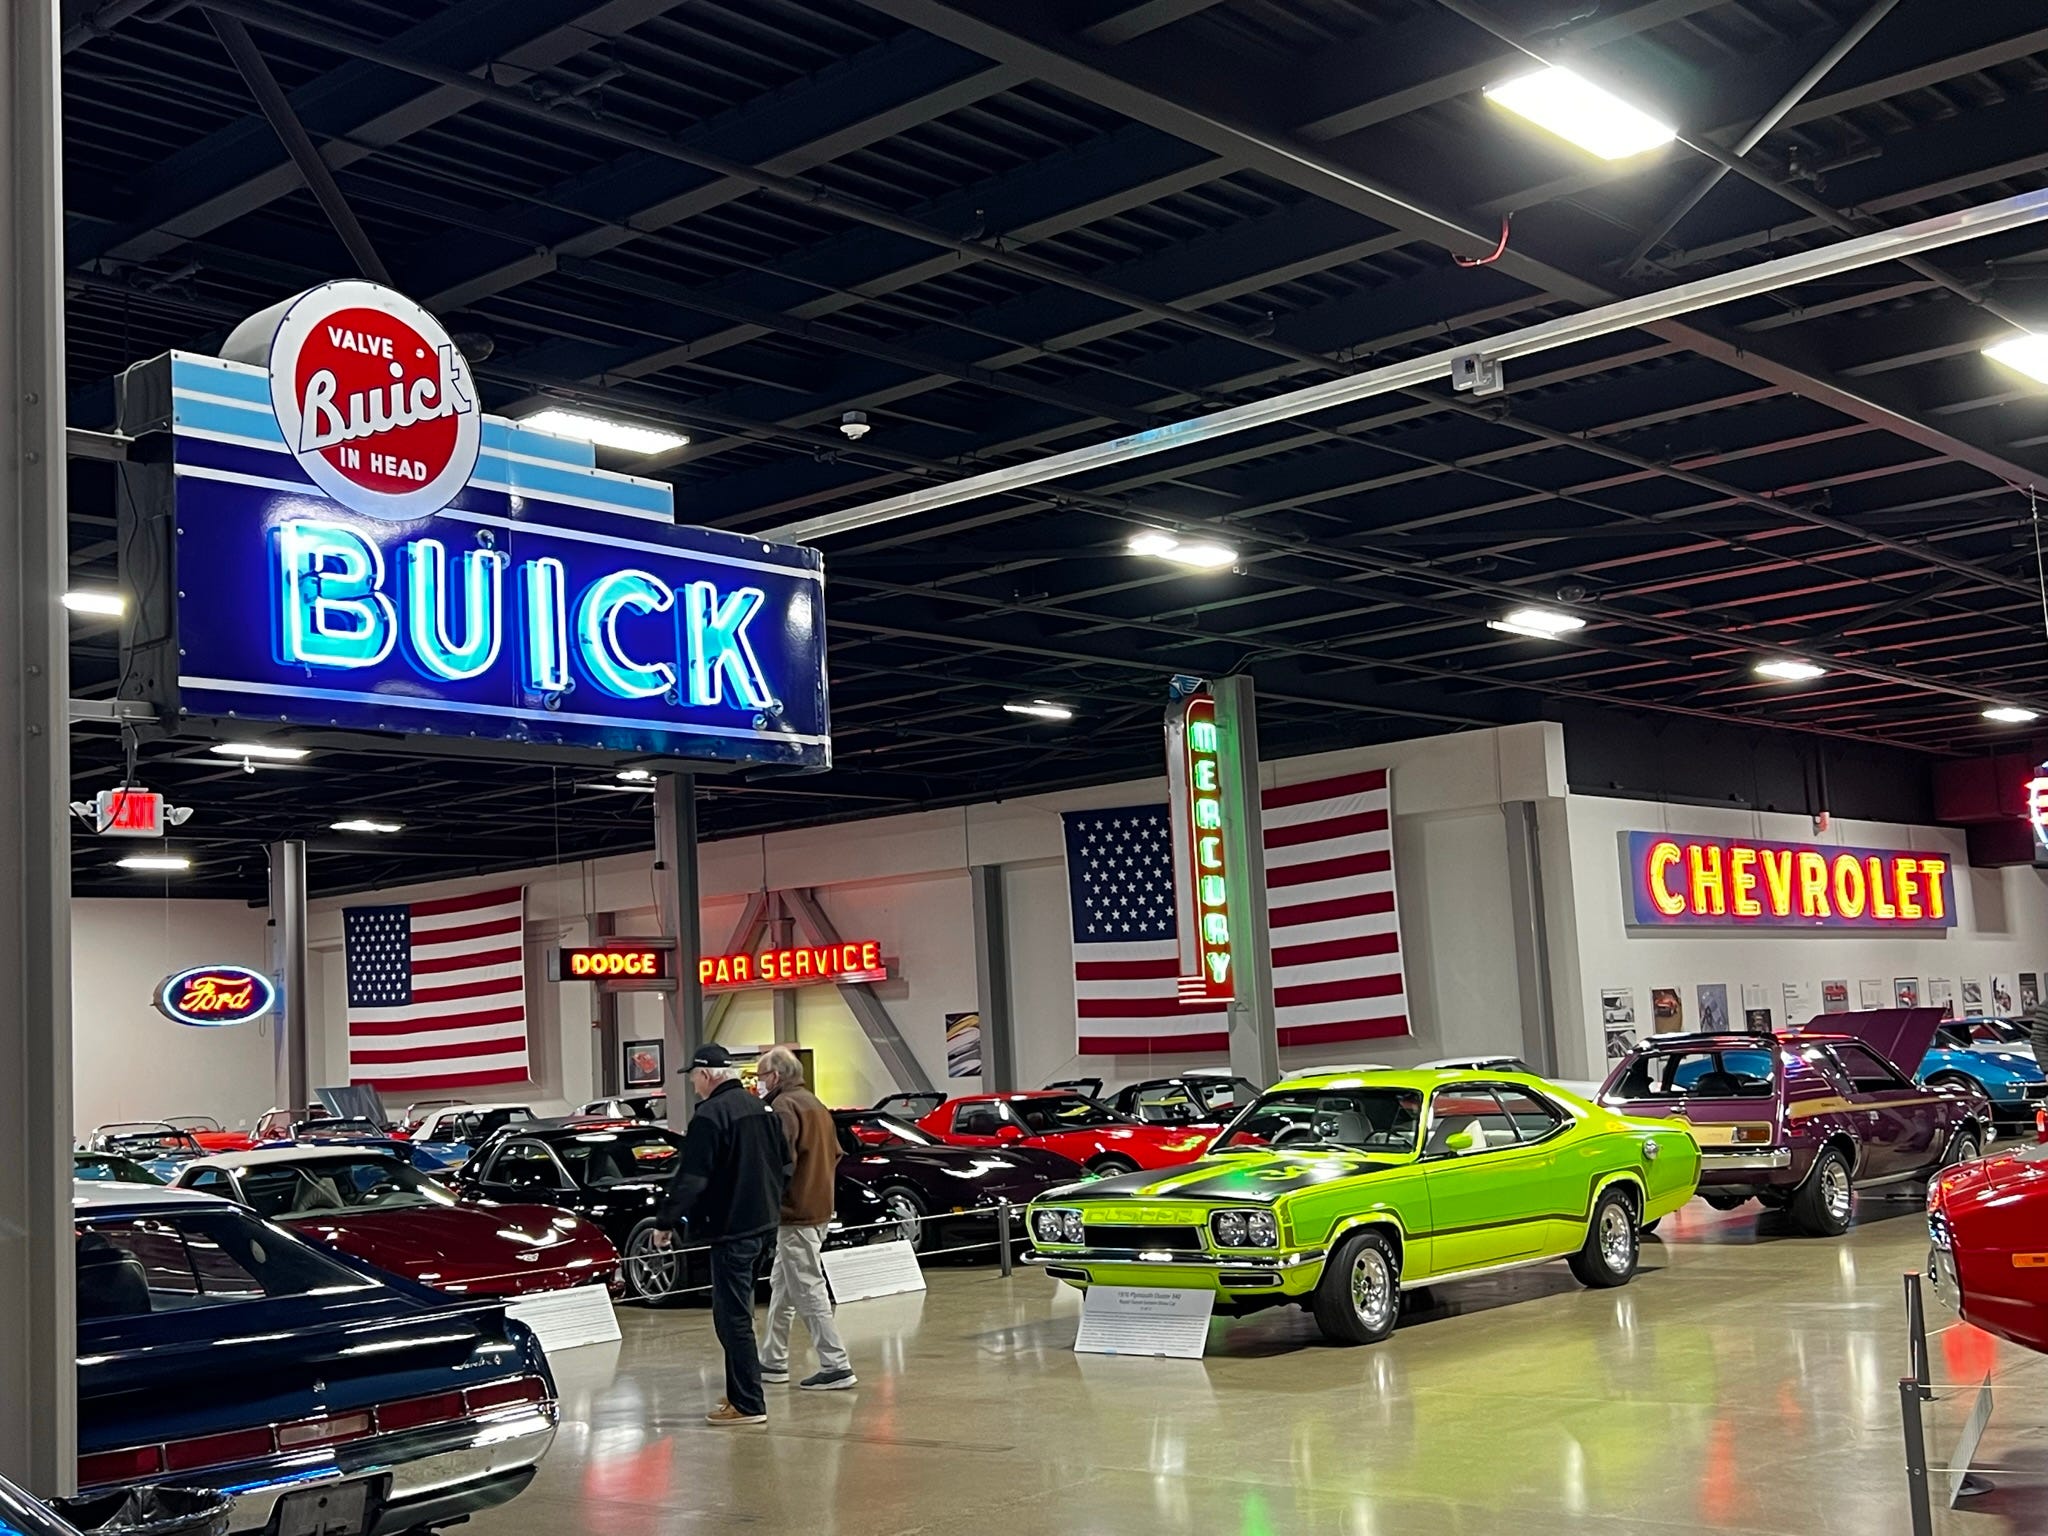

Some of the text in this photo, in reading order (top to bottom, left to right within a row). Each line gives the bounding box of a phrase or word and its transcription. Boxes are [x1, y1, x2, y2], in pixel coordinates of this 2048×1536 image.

[327, 326, 394, 359] VALVE
[298, 344, 472, 454] Buick
[339, 447, 427, 481] IN HEAD
[270, 518, 774, 711] BUICK
[113, 793, 156, 830] EXIT
[1190, 721, 1229, 983] MERCURY
[1648, 842, 1946, 919] CHEVROLET
[571, 953, 656, 975] DODGE
[761, 943, 877, 980] SERVICE
[178, 976, 253, 1012] Ford
